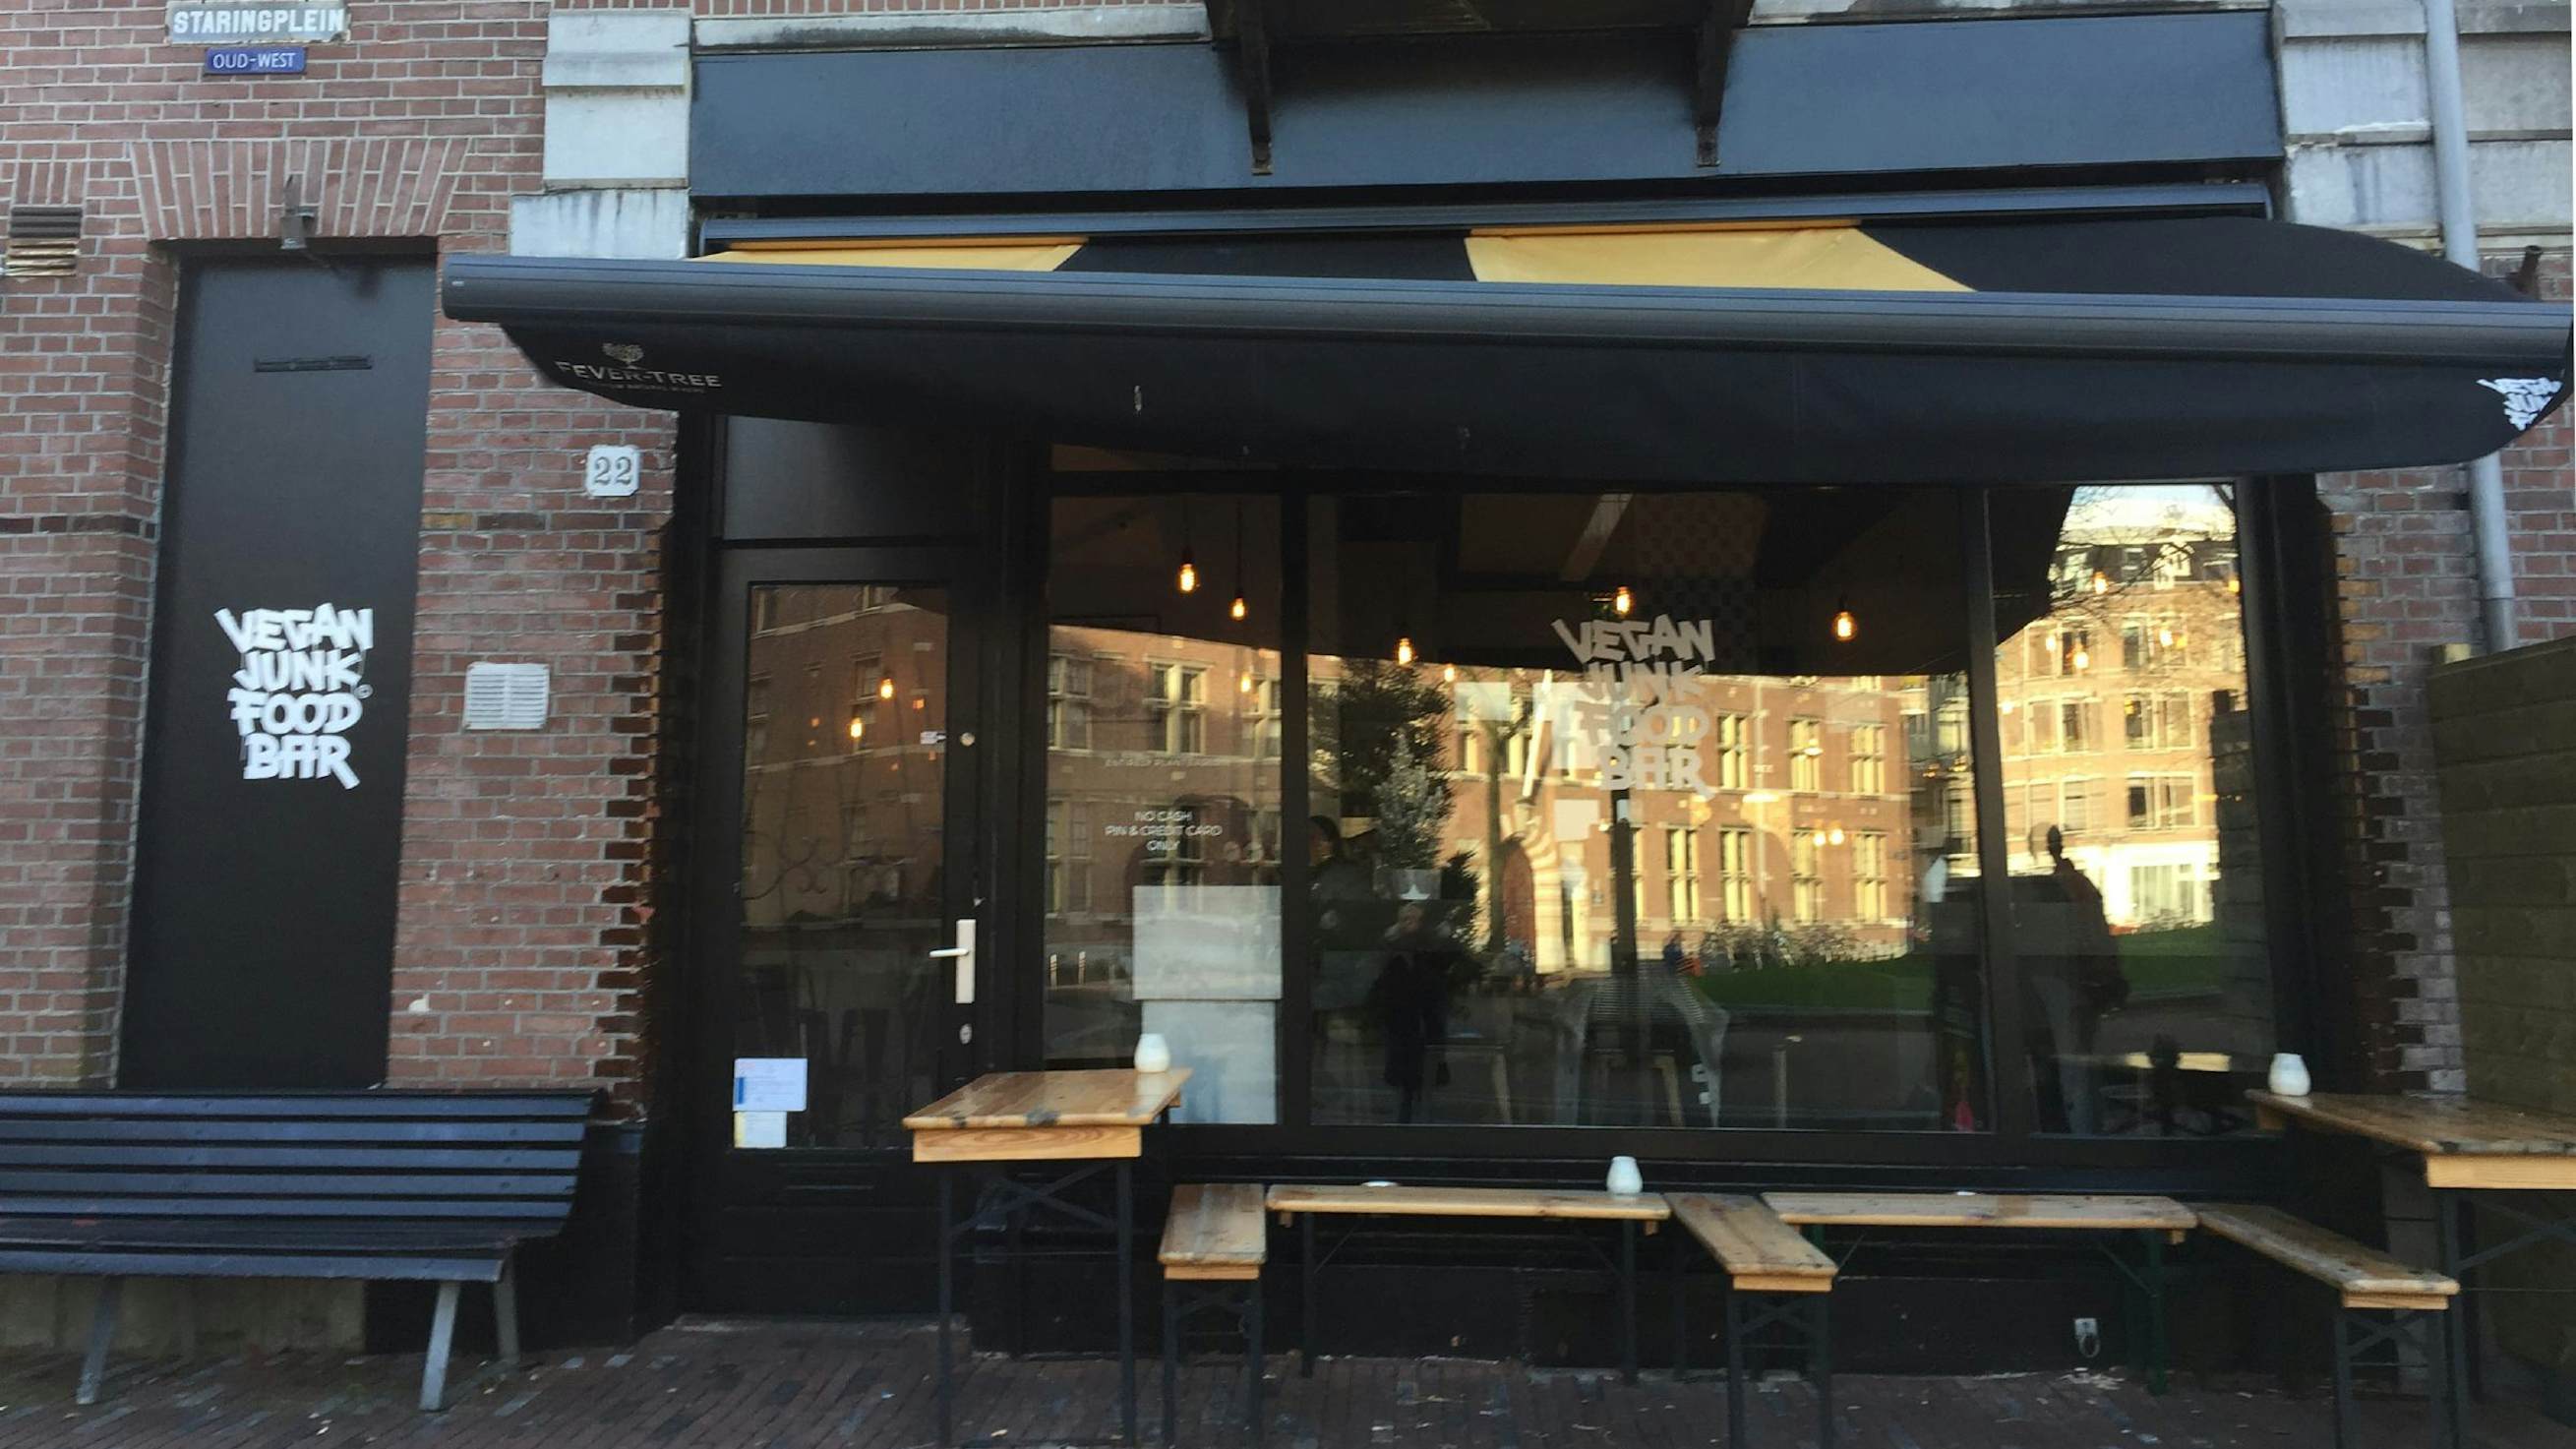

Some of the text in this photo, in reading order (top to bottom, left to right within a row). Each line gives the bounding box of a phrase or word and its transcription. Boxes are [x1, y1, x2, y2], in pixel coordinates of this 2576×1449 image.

[173, 9, 345, 34] STARINGPLEIN
[212, 52, 296, 69] OUD-WEST
[554, 360, 723, 388] FEVER-TREE
[594, 455, 631, 486] 22
[213, 602, 374, 654] VEGAN
[1551, 614, 1715, 664] VEGAN
[232, 648, 363, 693] JUNK
[1578, 660, 1706, 705] JUNK
[226, 687, 364, 737] FOOD
[1574, 701, 1710, 748] FOOD
[243, 732, 361, 790] BAR
[1598, 745, 1718, 803] BAR
[1105, 824, 1223, 837] PIN & CREDIT CARD
[1134, 811, 1193, 822] NO CASH
[1146, 839, 1180, 851] ONLY
